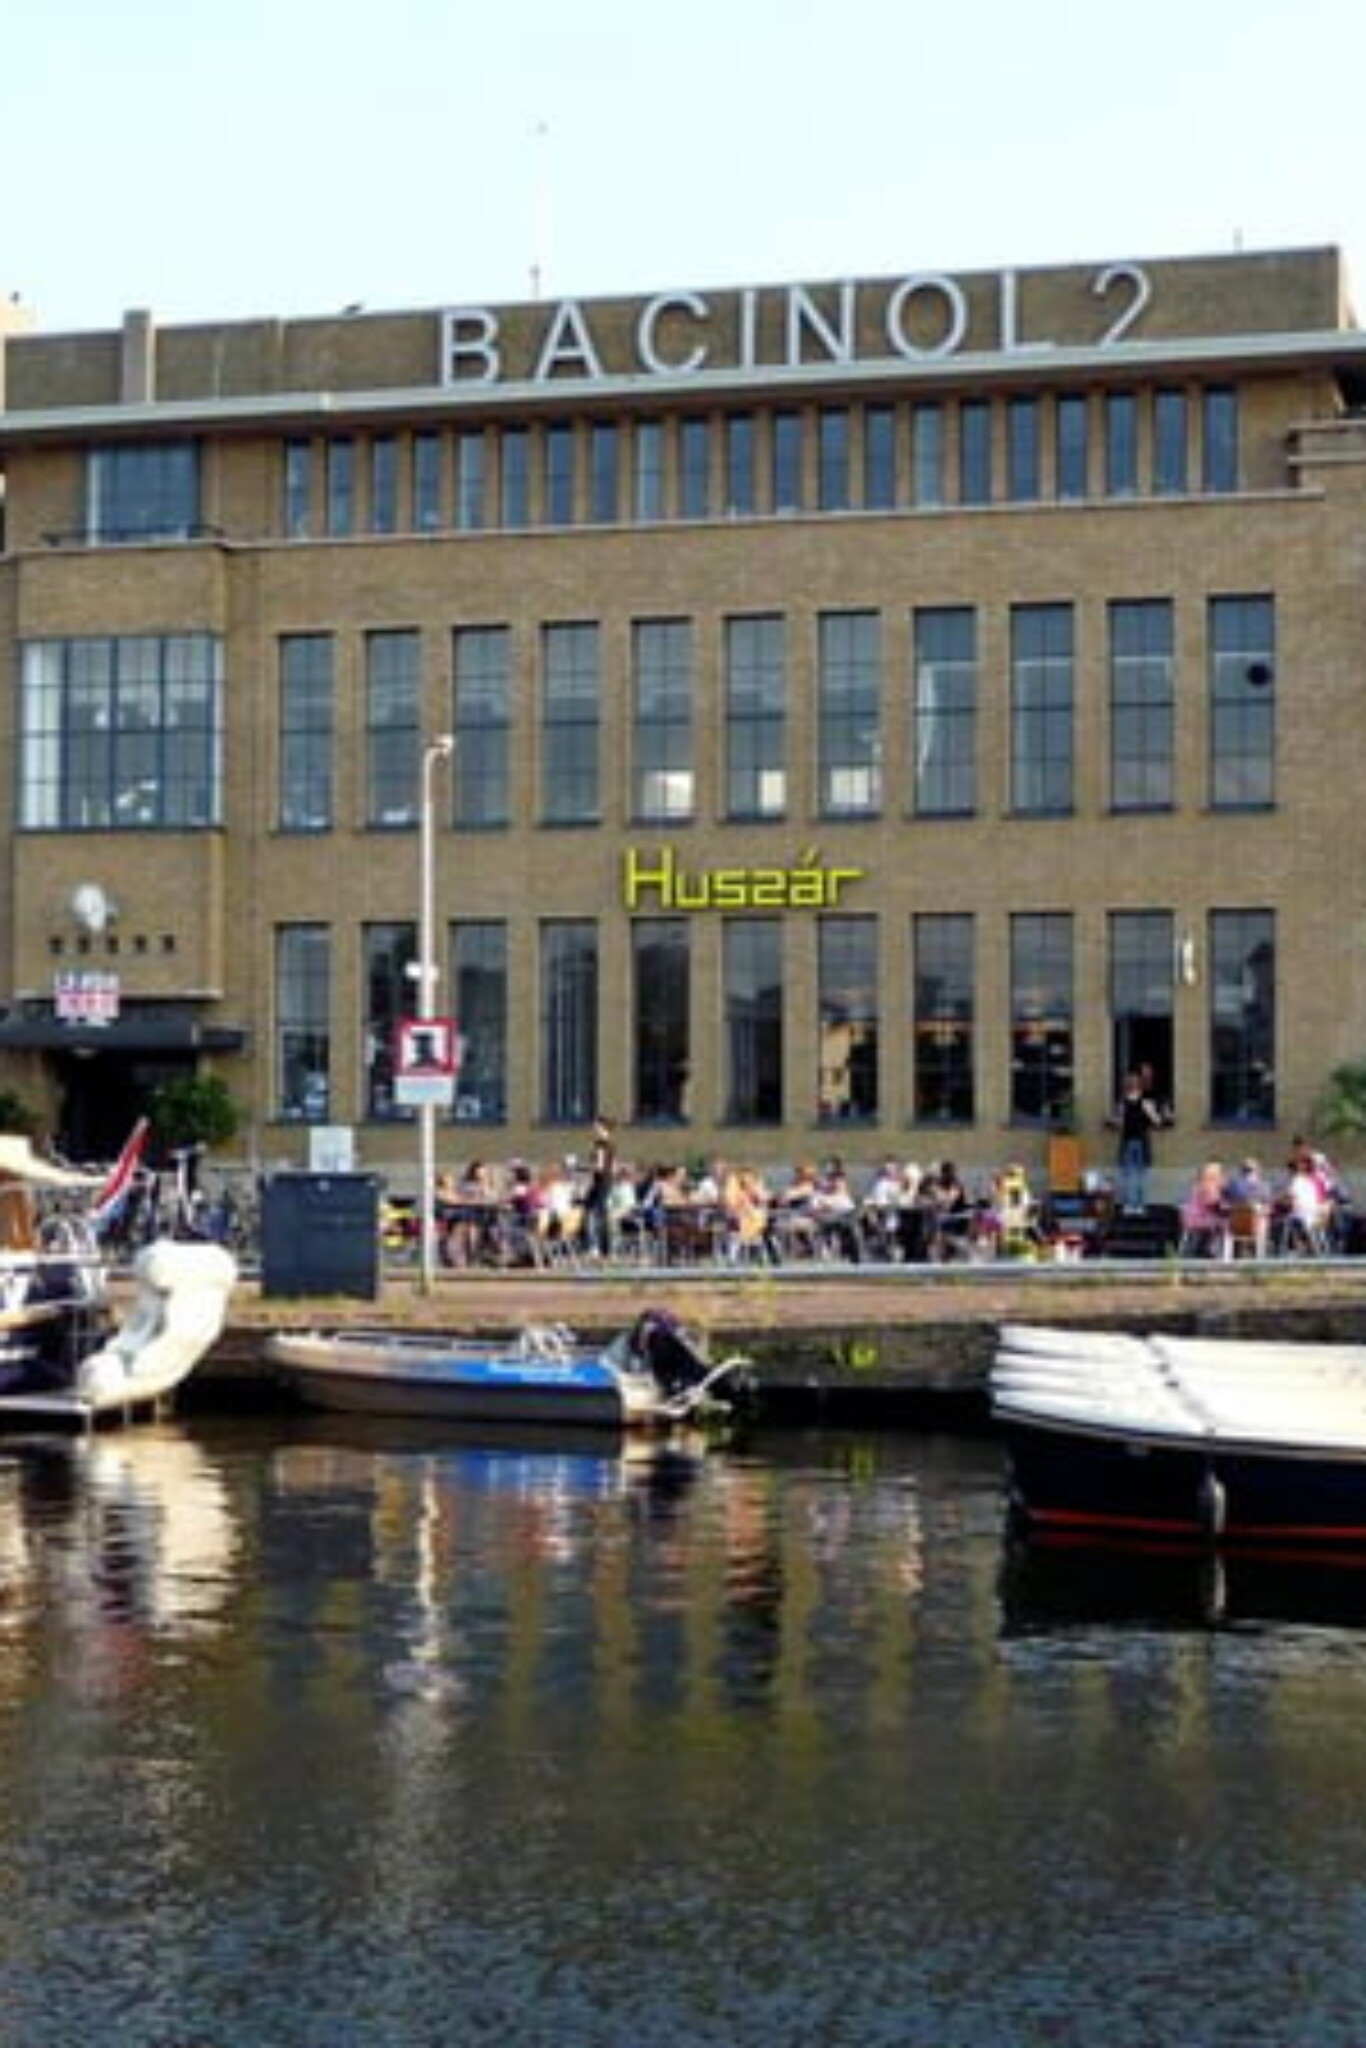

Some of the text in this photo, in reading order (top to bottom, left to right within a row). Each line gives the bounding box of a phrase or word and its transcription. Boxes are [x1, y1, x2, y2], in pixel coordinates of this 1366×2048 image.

[438, 265, 1151, 387] BACINOL 2
[625, 846, 865, 907] Huszár
